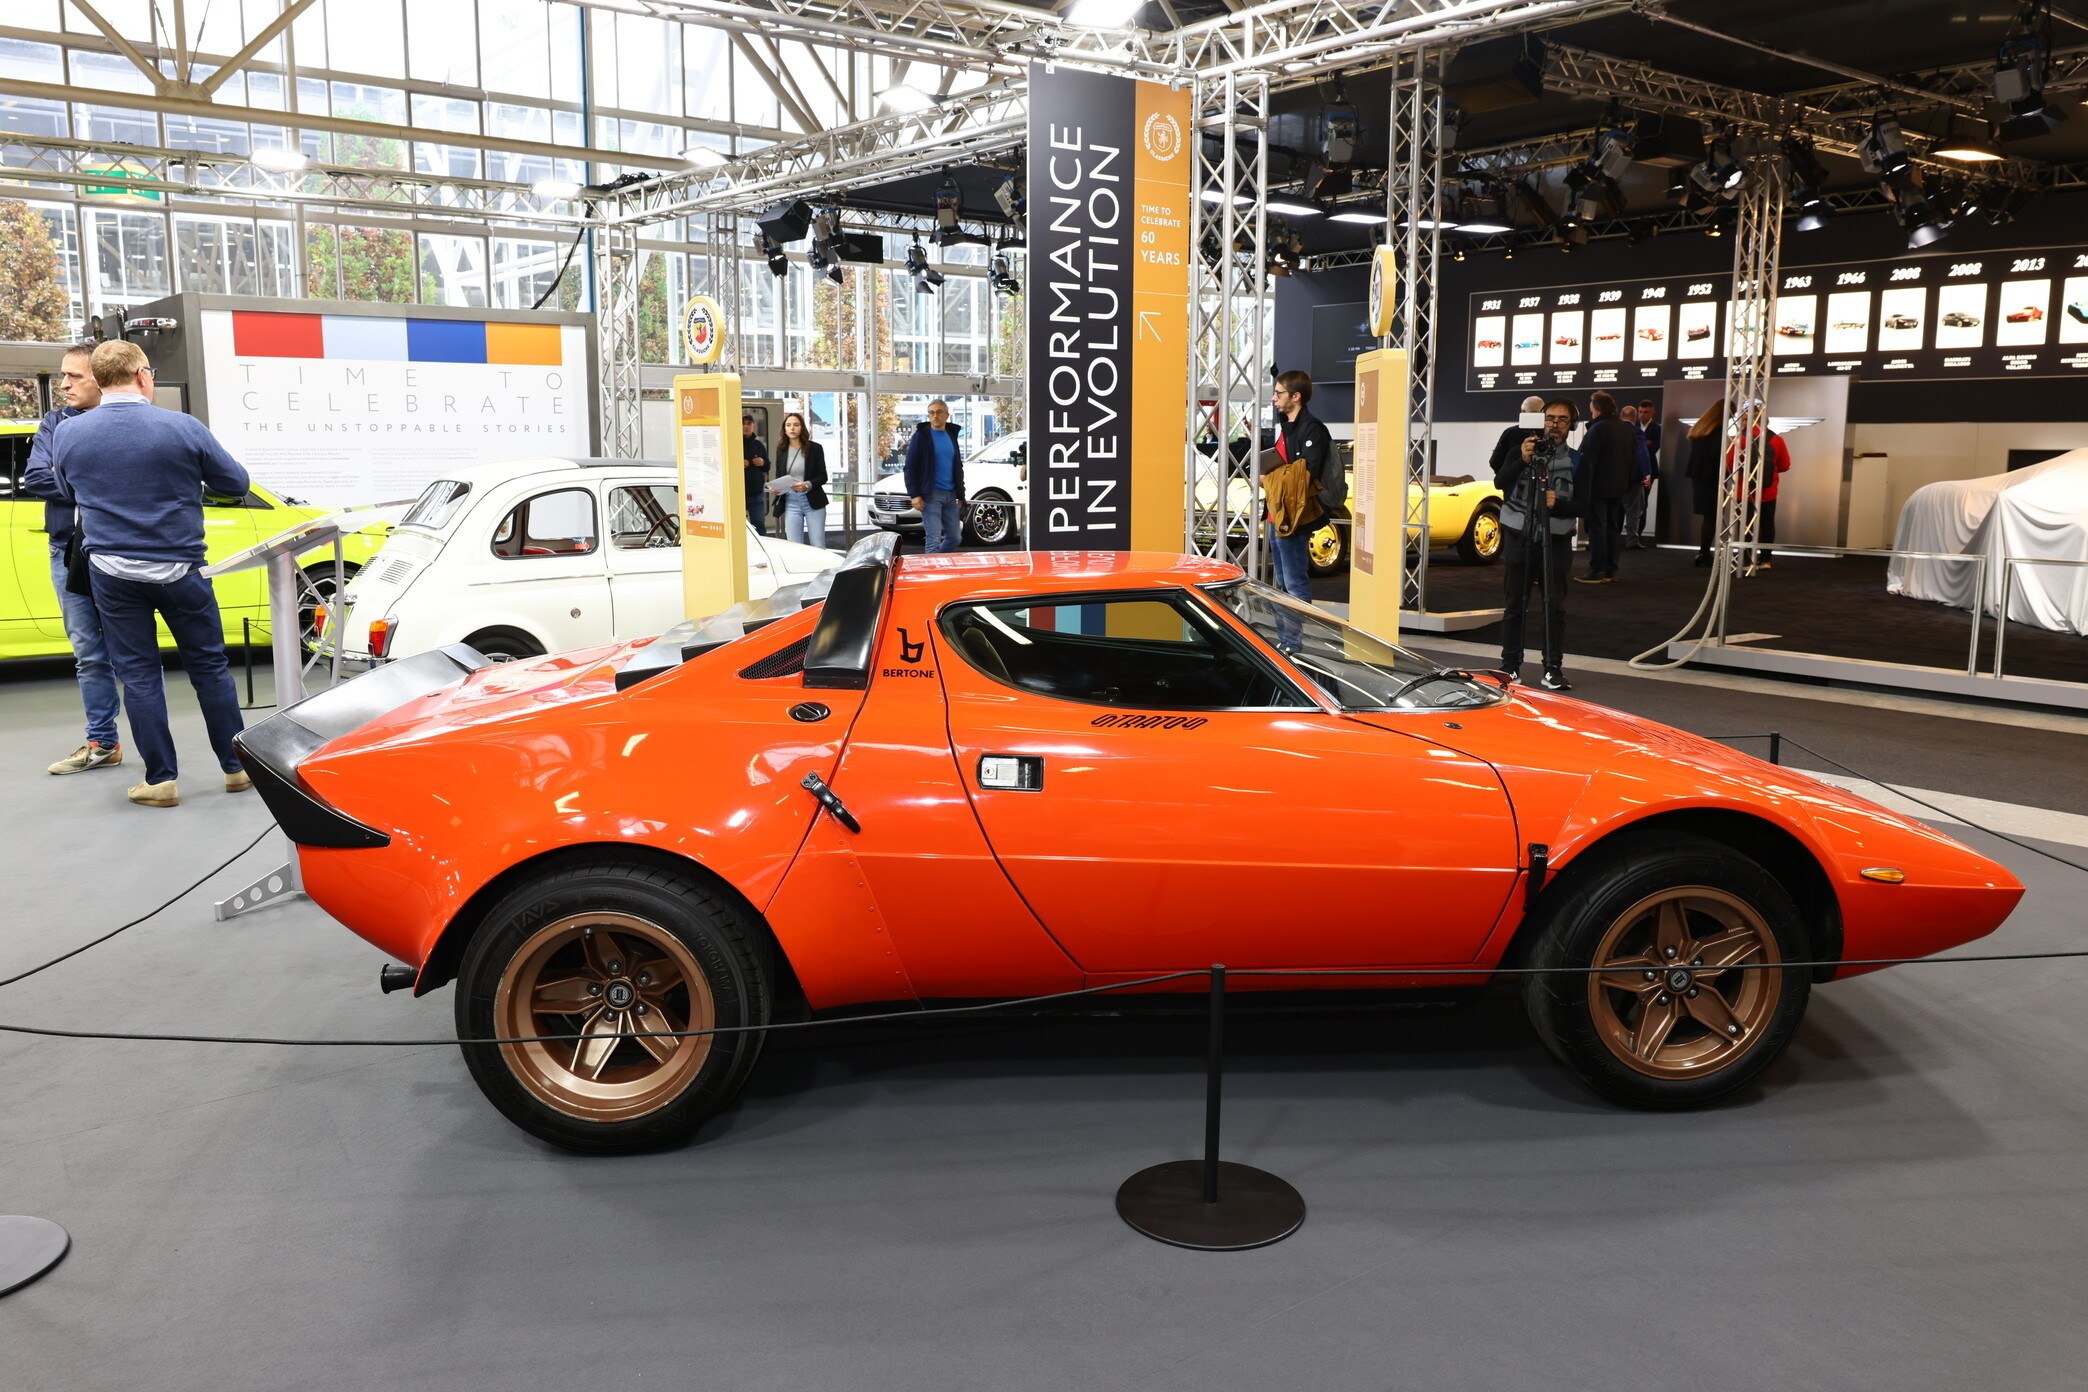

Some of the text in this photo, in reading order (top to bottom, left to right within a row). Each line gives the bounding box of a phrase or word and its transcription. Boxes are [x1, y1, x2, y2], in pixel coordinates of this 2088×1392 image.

[1141, 204, 1171, 215] TIME TO
[1141, 213, 1181, 228] CELEBRATE
[1141, 231, 1156, 244] 60
[1141, 249, 1181, 266] YEARS
[2010, 257, 2046, 273] 2013
[1889, 267, 1922, 281] 2008
[1948, 262, 1983, 277] 2008
[1783, 275, 1813, 289] 1963
[1836, 271, 1866, 286] 1966
[1598, 290, 1622, 303] 1939
[1686, 283, 1713, 296] 1952
[1518, 297, 1541, 308] 1937
[1048, 123, 1082, 533] PERFORMANCE
[1086, 144, 1120, 530] IN EVOLUTION
[239, 364, 563, 390] TIME TO
[242, 391, 564, 414] CELEBRATE
[243, 422, 565, 433] THE UNSTOPPABLE STORIES
[882, 669, 935, 679] BERTONE
[1090, 713, 1209, 731] STRATOS
